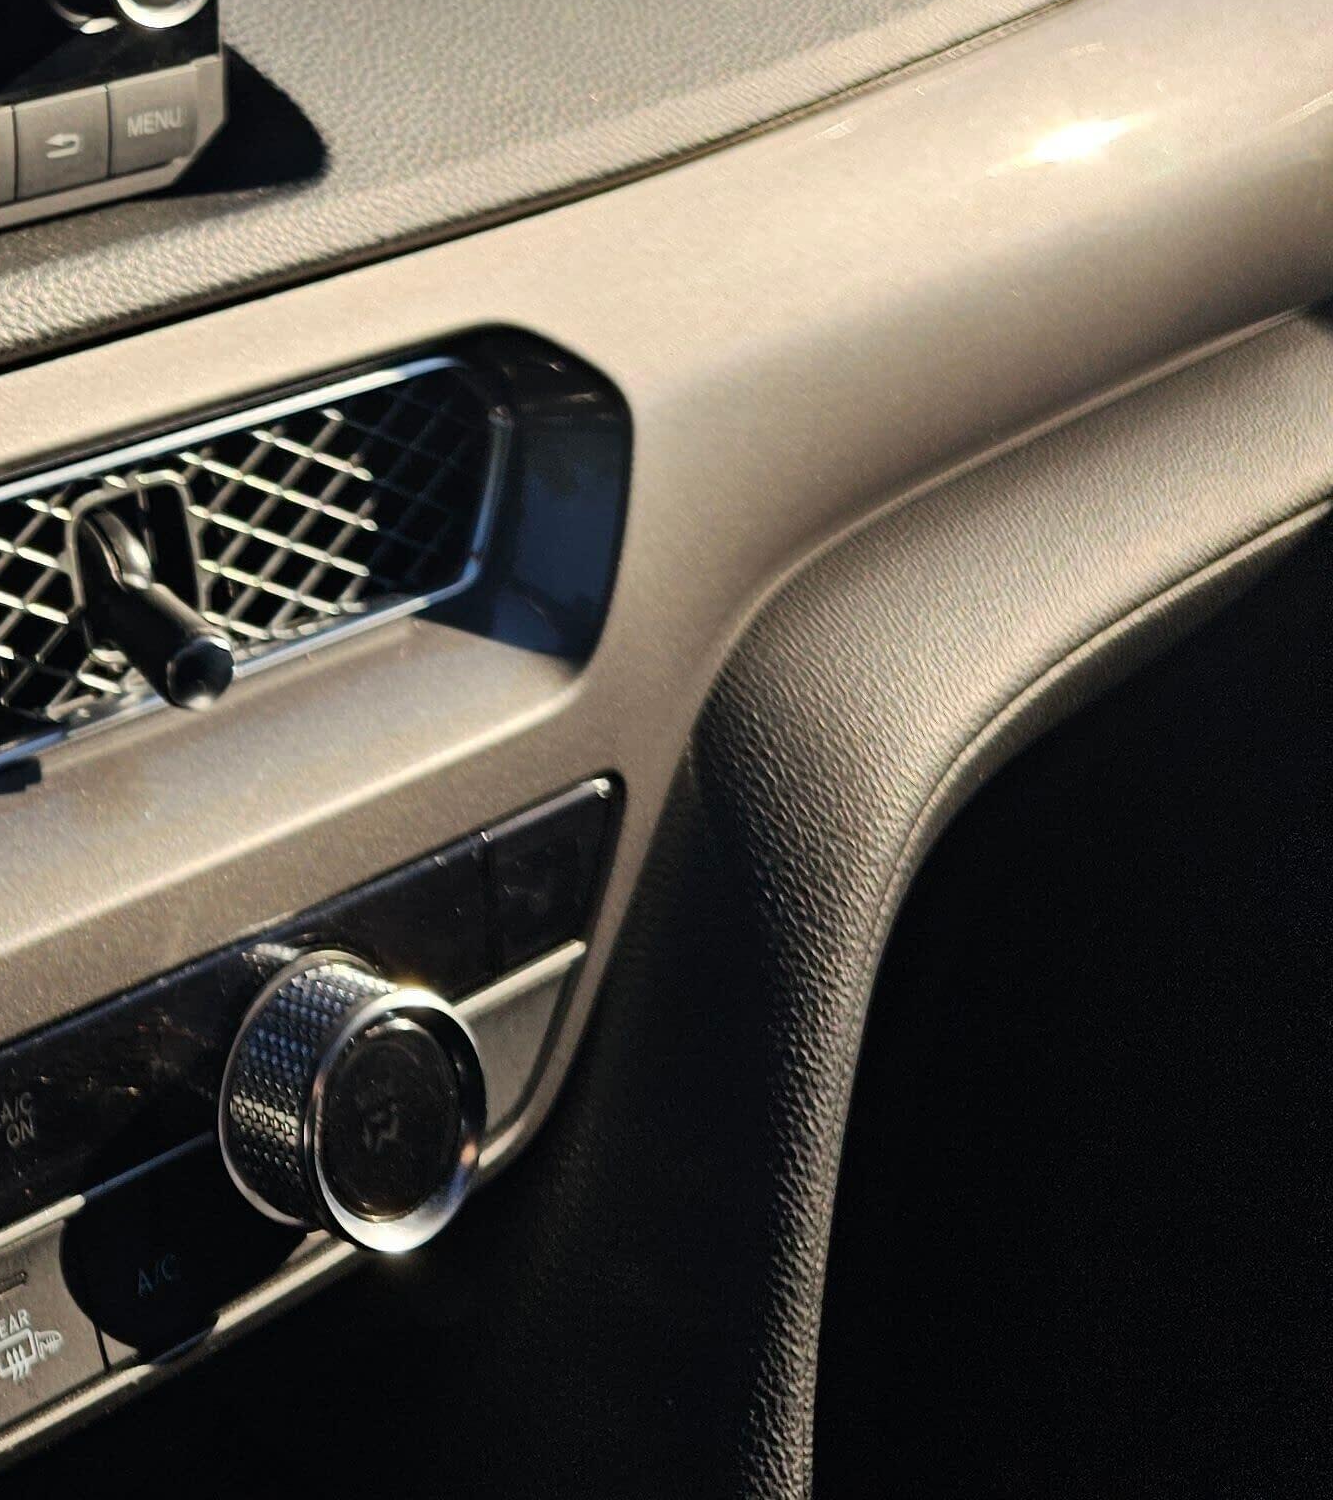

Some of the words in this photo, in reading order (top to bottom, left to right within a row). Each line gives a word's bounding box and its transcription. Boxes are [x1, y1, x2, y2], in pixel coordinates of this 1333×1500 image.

[126, 106, 183, 139] MENU
[0, 1092, 34, 1125] A/C
[5, 1117, 37, 1148] ON
[136, 1251, 182, 1299] A/C
